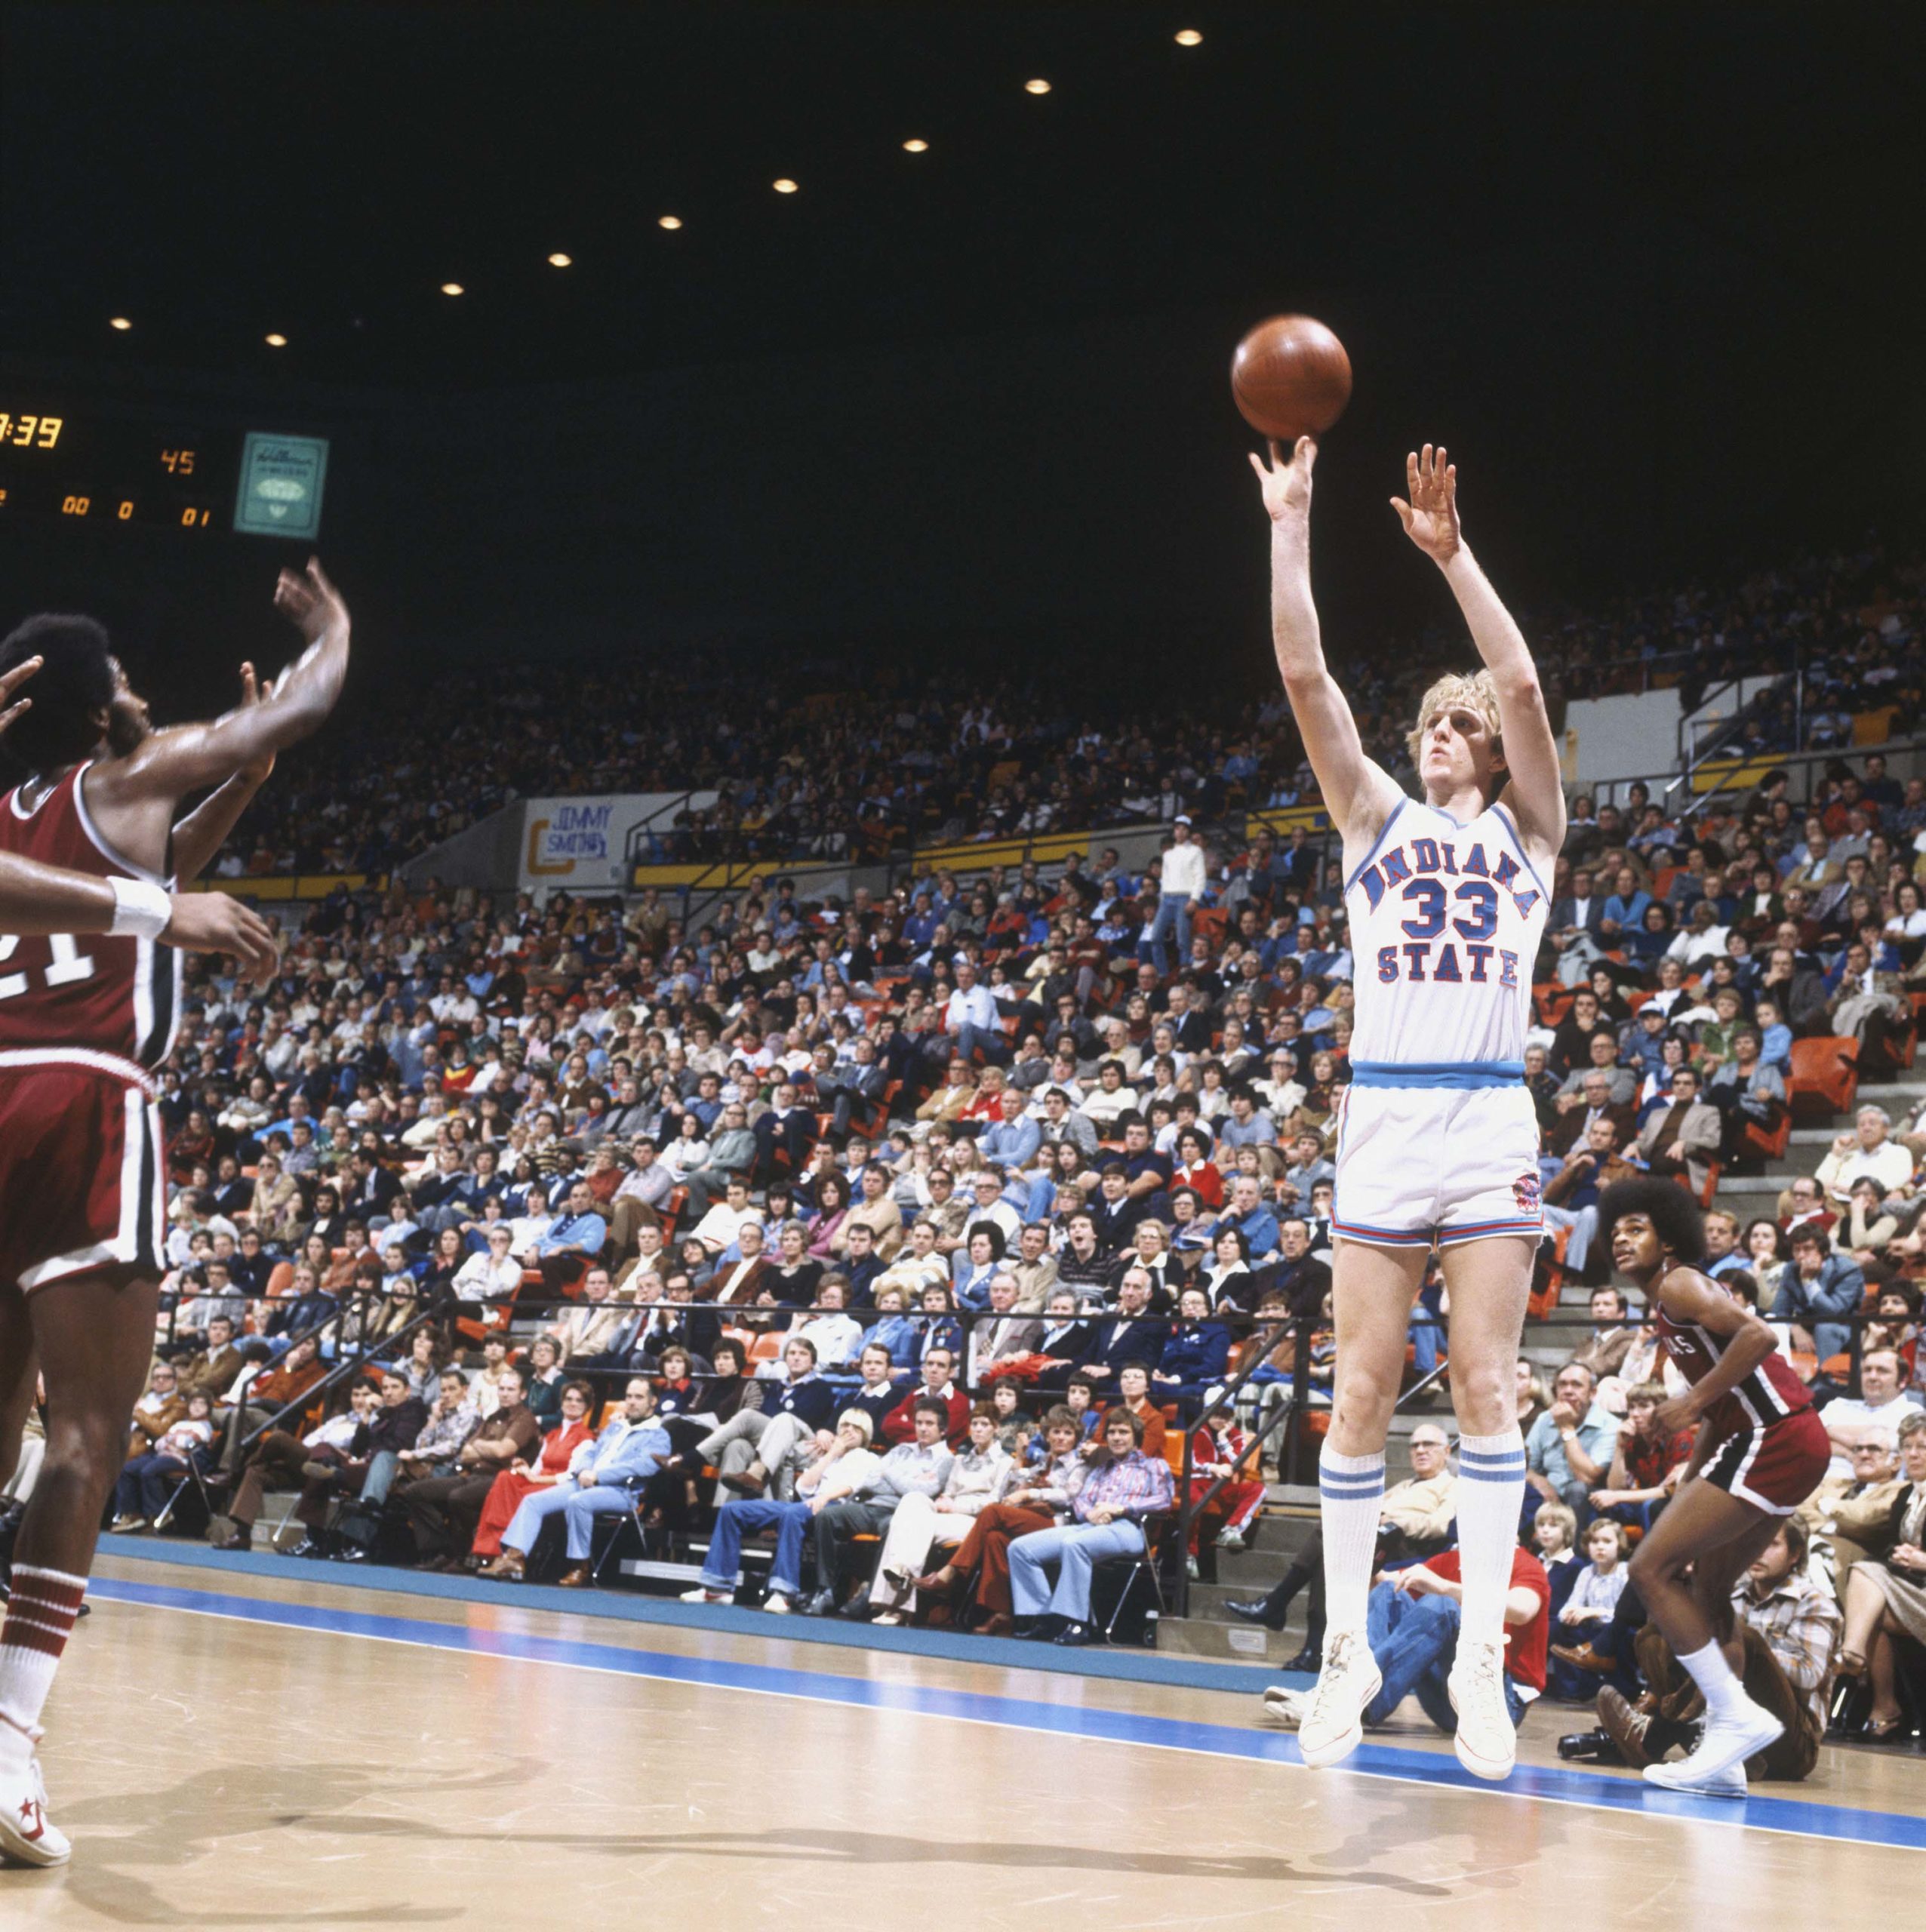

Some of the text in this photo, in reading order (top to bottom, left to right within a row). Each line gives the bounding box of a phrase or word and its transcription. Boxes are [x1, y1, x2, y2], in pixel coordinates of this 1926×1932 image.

[161, 449, 195, 474] 45
[63, 496, 210, 528] 00 0 01
[552, 804, 613, 830] JIMMY
[1358, 838, 1540, 921] INDIANA
[1401, 878, 1499, 941] 33
[1377, 943, 1519, 989] STATE
